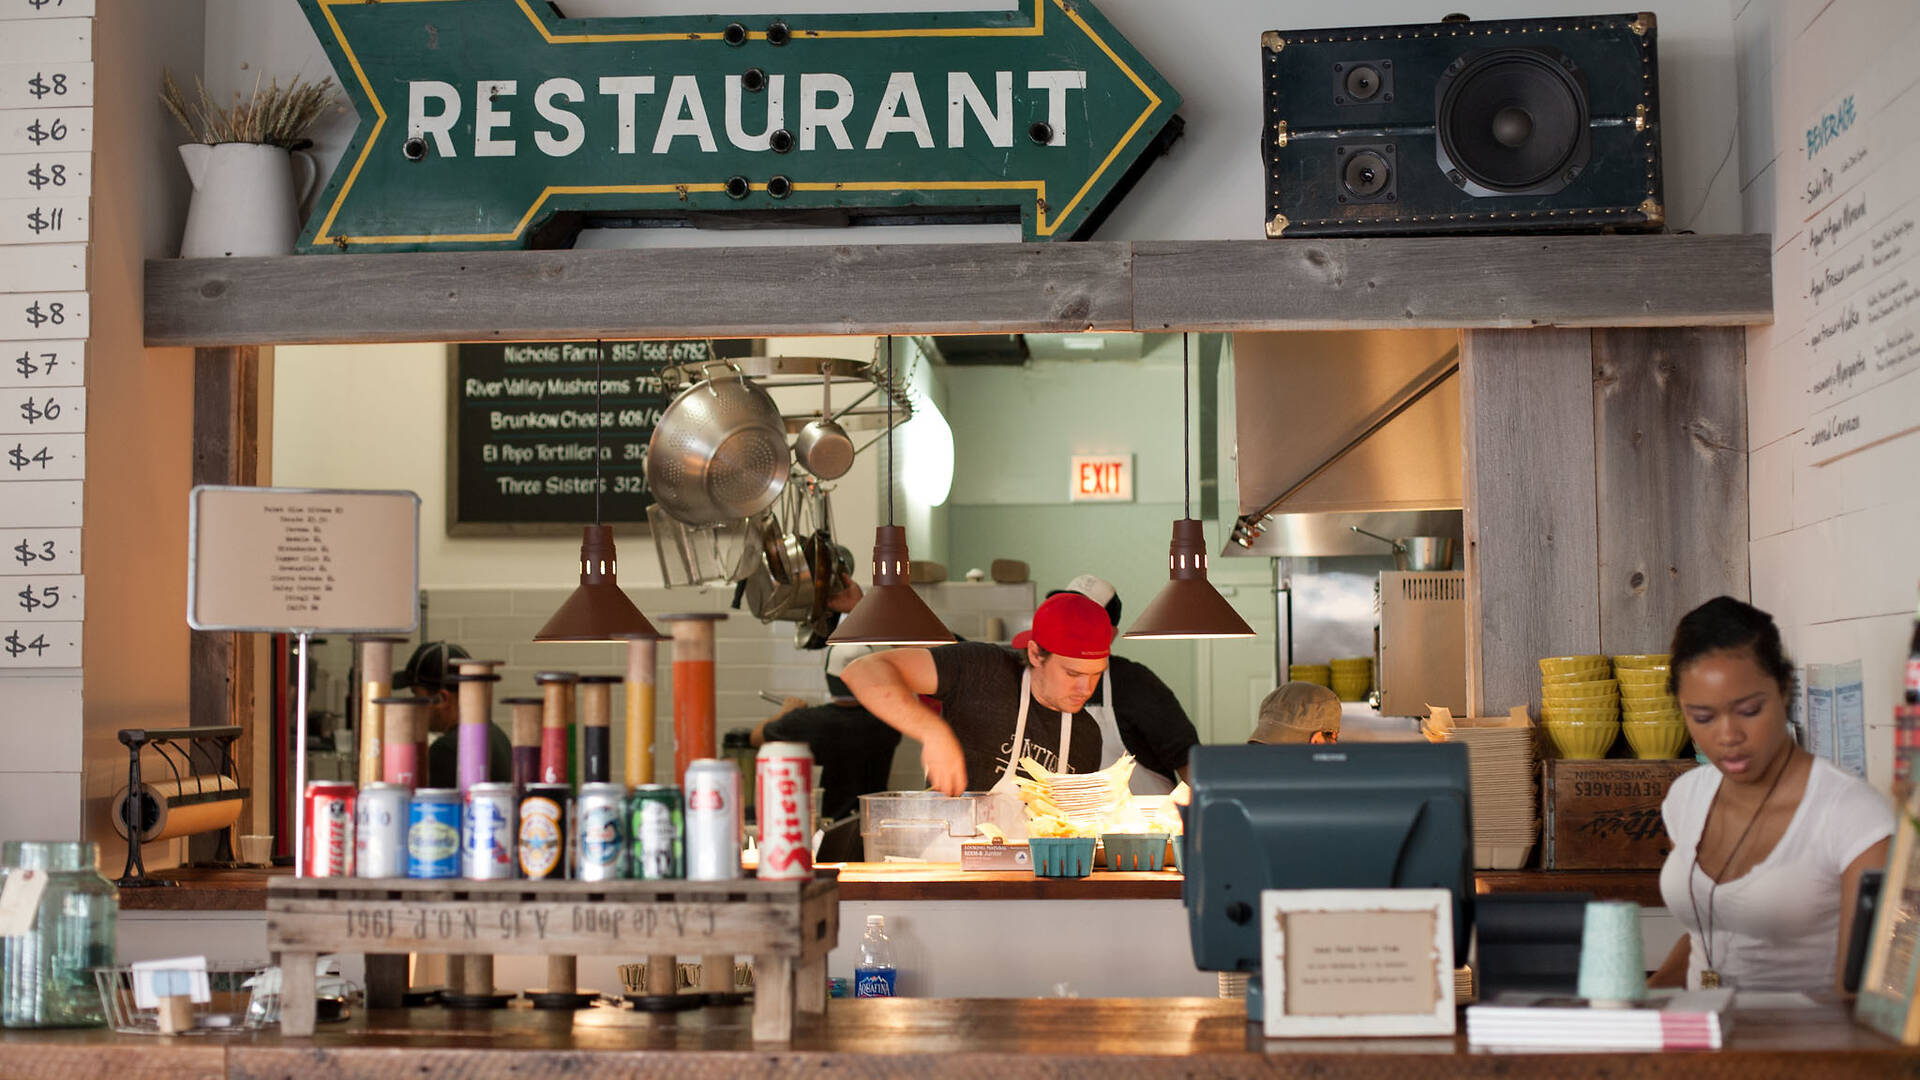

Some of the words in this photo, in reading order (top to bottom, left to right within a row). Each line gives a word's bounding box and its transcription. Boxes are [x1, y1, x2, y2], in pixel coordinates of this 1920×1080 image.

[28, 72, 67, 99] $8
[407, 70, 1087, 158] RESTAURANT
[27, 118, 67, 146] $6
[27, 163, 66, 190] $8
[27, 207, 63, 234] $11
[26, 300, 65, 328] $8
[16, 351, 58, 379] $7
[504, 345, 559, 363] Nichols
[562, 344, 604, 362] Farm
[466, 378, 502, 397] River
[503, 378, 546, 400] Valley
[547, 378, 630, 395] Mushrooms
[20, 397, 60, 425] $6
[490, 411, 559, 430] Brunkow
[560, 410, 615, 428] Cheese
[8, 443, 53, 471] $4
[535, 443, 612, 461] Tortillera
[496, 476, 541, 494] Three
[545, 476, 607, 494] Sisters
[1080, 462, 1122, 494] EXIT
[14, 539, 56, 566] $3
[18, 585, 60, 612] $5
[5, 630, 50, 657] $4
[1575, 781, 1662, 797] BEVERAGES
[329, 819, 346, 877] TECATE
[346, 908, 395, 938] 1961
